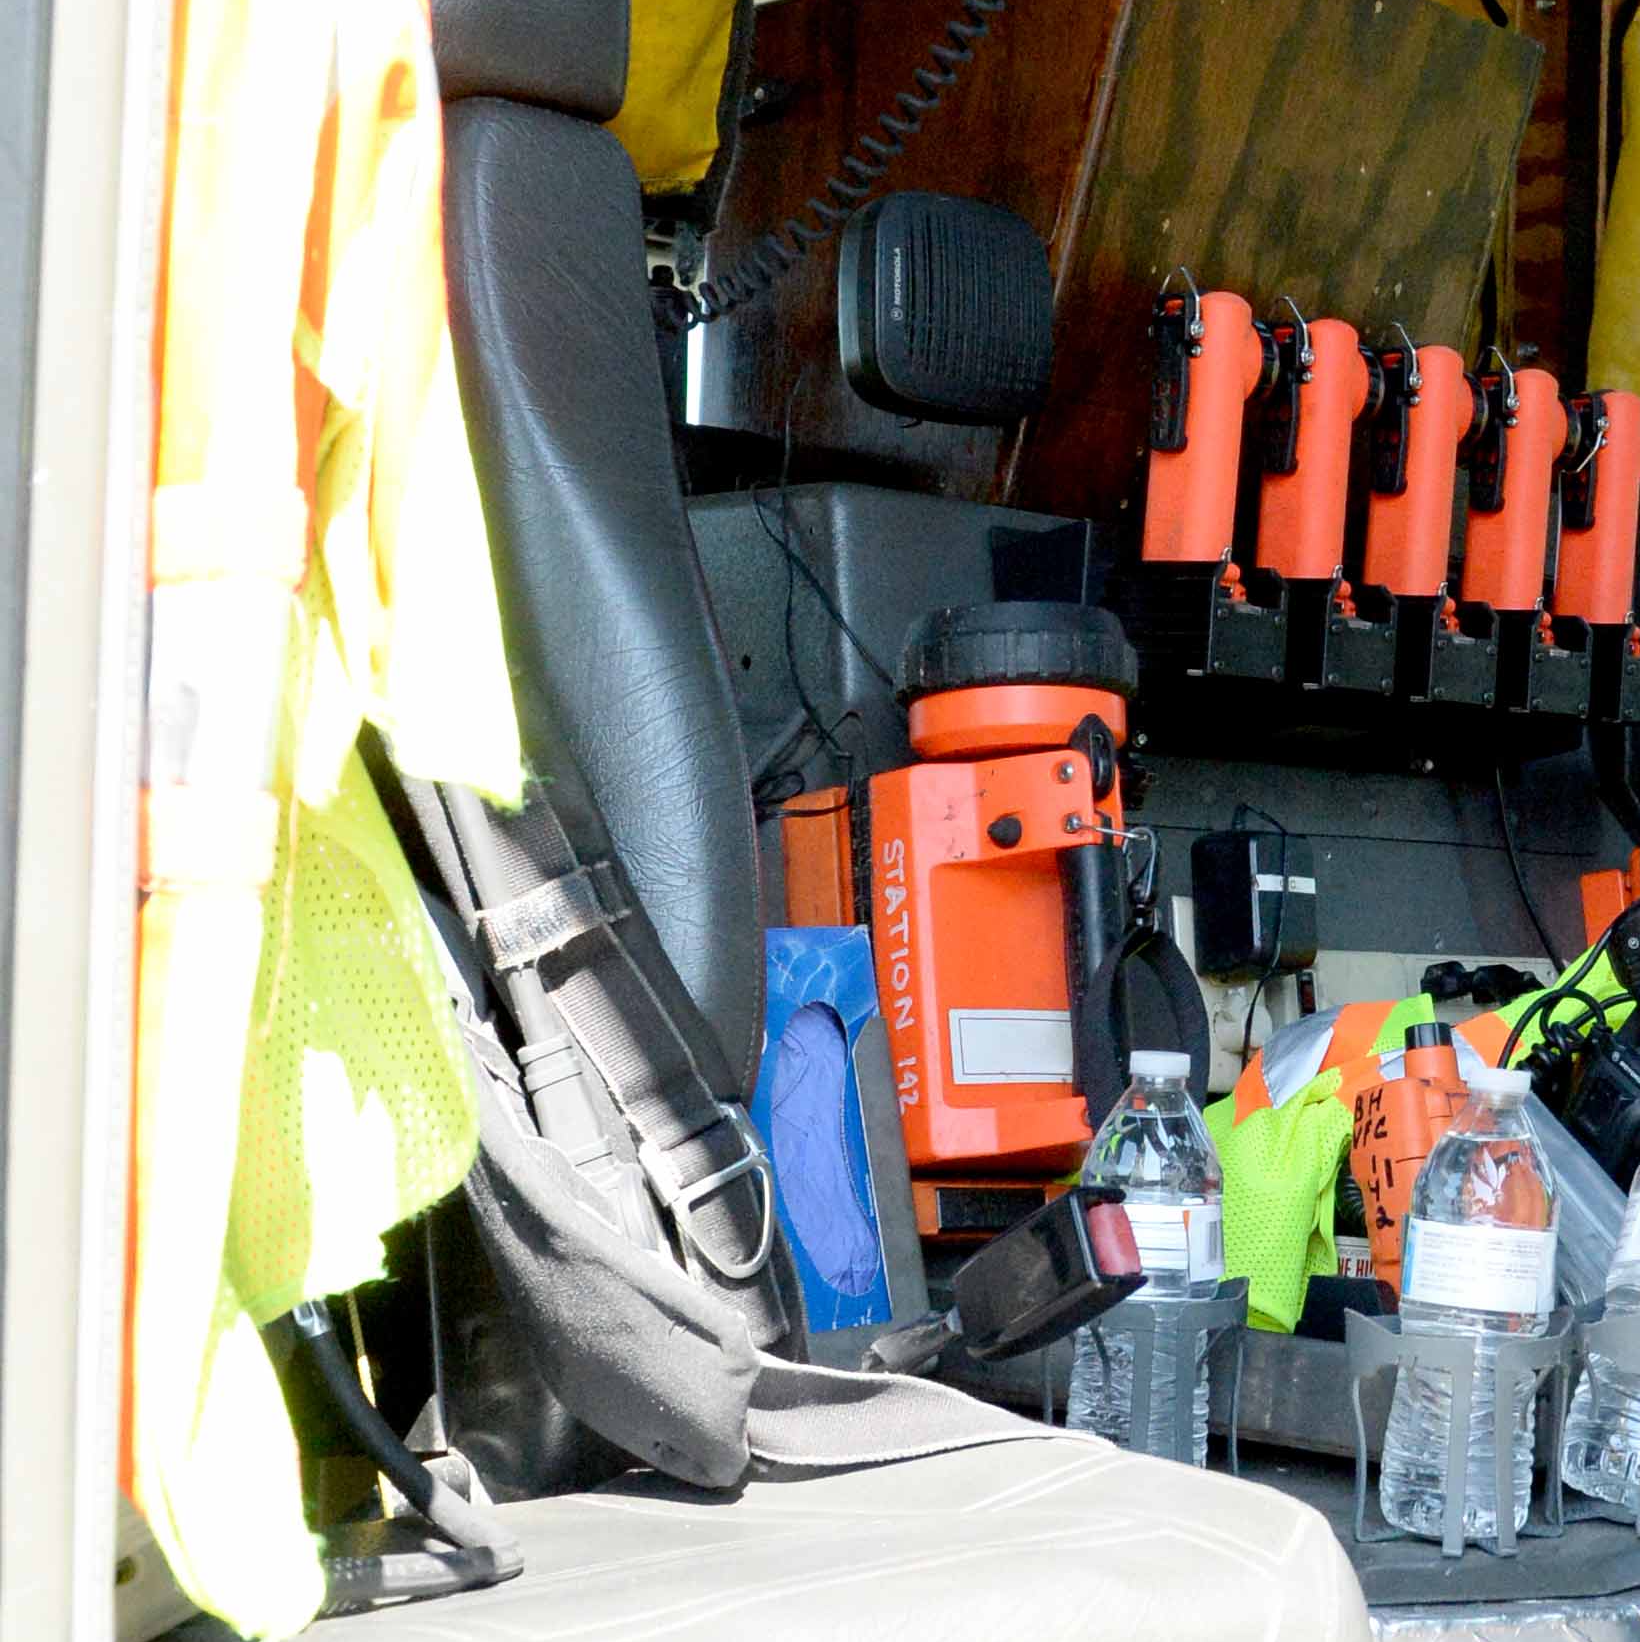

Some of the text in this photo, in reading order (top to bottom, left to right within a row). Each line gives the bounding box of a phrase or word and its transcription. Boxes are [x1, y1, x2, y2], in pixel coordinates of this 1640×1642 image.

[893, 247, 902, 306] MOTOROLA
[882, 838, 920, 1115] STATION 142
